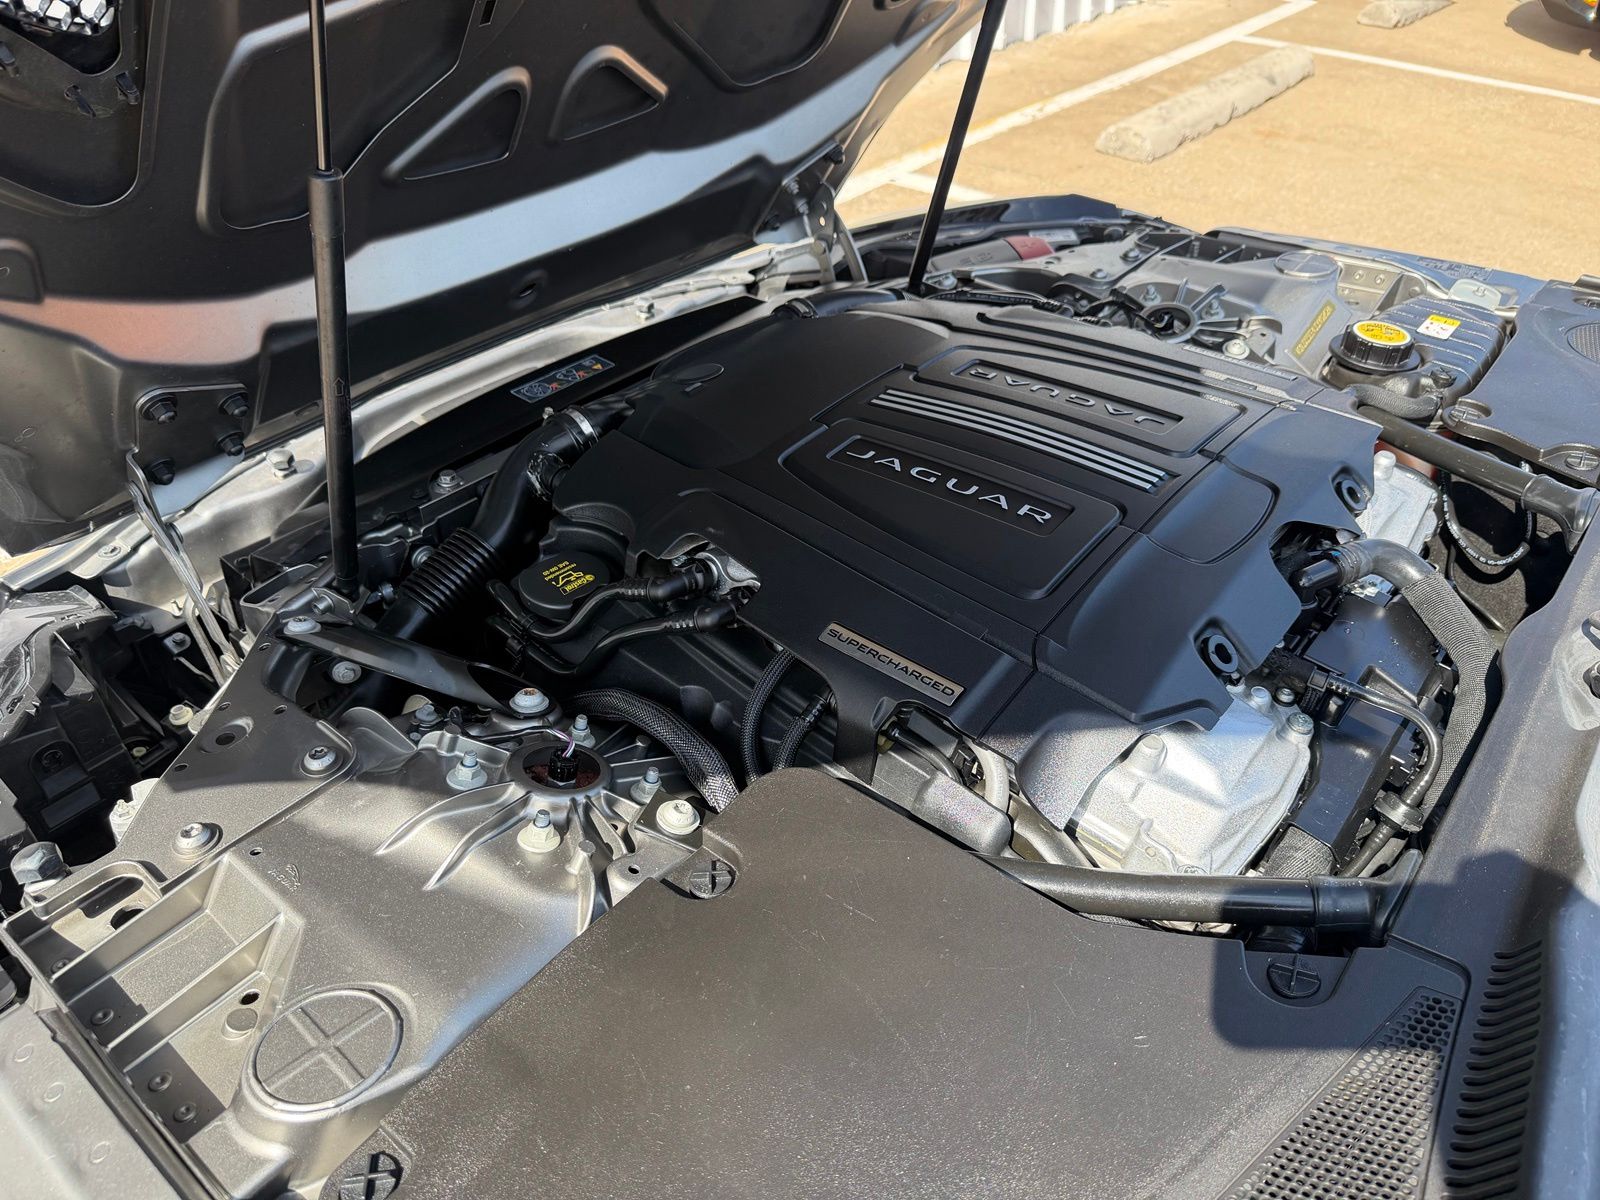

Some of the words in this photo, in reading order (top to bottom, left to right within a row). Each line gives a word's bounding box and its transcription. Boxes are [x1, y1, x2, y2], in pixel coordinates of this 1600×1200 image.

[968, 367, 1166, 426] JAGUAR
[846, 450, 1052, 524] JAGUAR
[564, 577, 587, 593] Castrol
[826, 628, 956, 697] SUPERCHARGED
